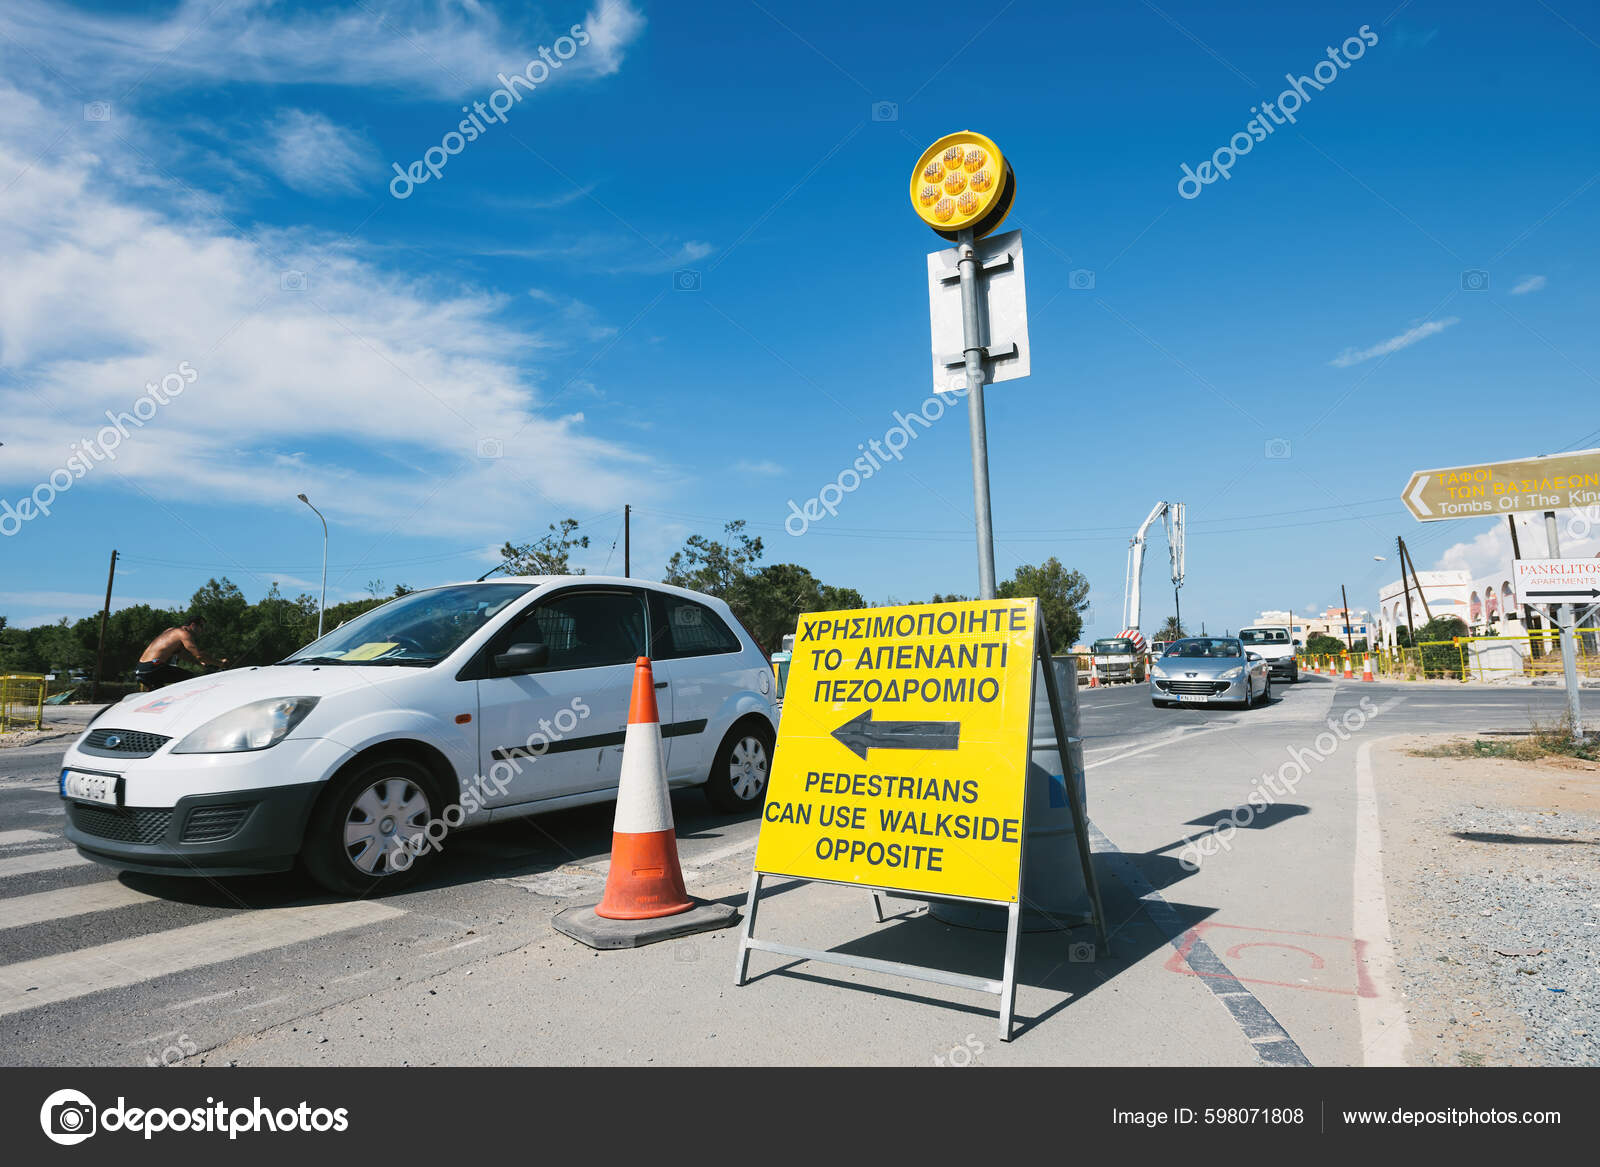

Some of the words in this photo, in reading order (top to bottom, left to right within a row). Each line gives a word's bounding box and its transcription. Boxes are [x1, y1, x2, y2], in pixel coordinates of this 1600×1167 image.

[1436, 469, 1493, 487] ΤΑΦΟΙ
[1447, 485, 1485, 499] ΤΩΝ
[1493, 472, 1600, 495] ΒΑΣΙΛΕΩΝ
[1438, 500, 1492, 514] Tombs
[1499, 496, 1519, 509] Of
[1527, 493, 1560, 507] The
[1569, 489, 1600, 504] Kin
[1530, 577, 1597, 585] APARTMENTS
[801, 607, 1027, 642] ΧΡΗΣΙΜΟΠΟΙΗΤΕ
[811, 648, 843, 671] ΤΟ
[855, 642, 1008, 670] ΑΠΕΝΑΝΤΙ
[814, 677, 1000, 703] ΠΕΖΟΔΡΟΜΙΟ
[805, 771, 979, 804] PEDESTRIANS
[765, 801, 812, 825] CAN
[819, 805, 867, 830] USE
[879, 809, 1019, 843] WALKSIDE
[815, 837, 944, 872] OPPOSITE
